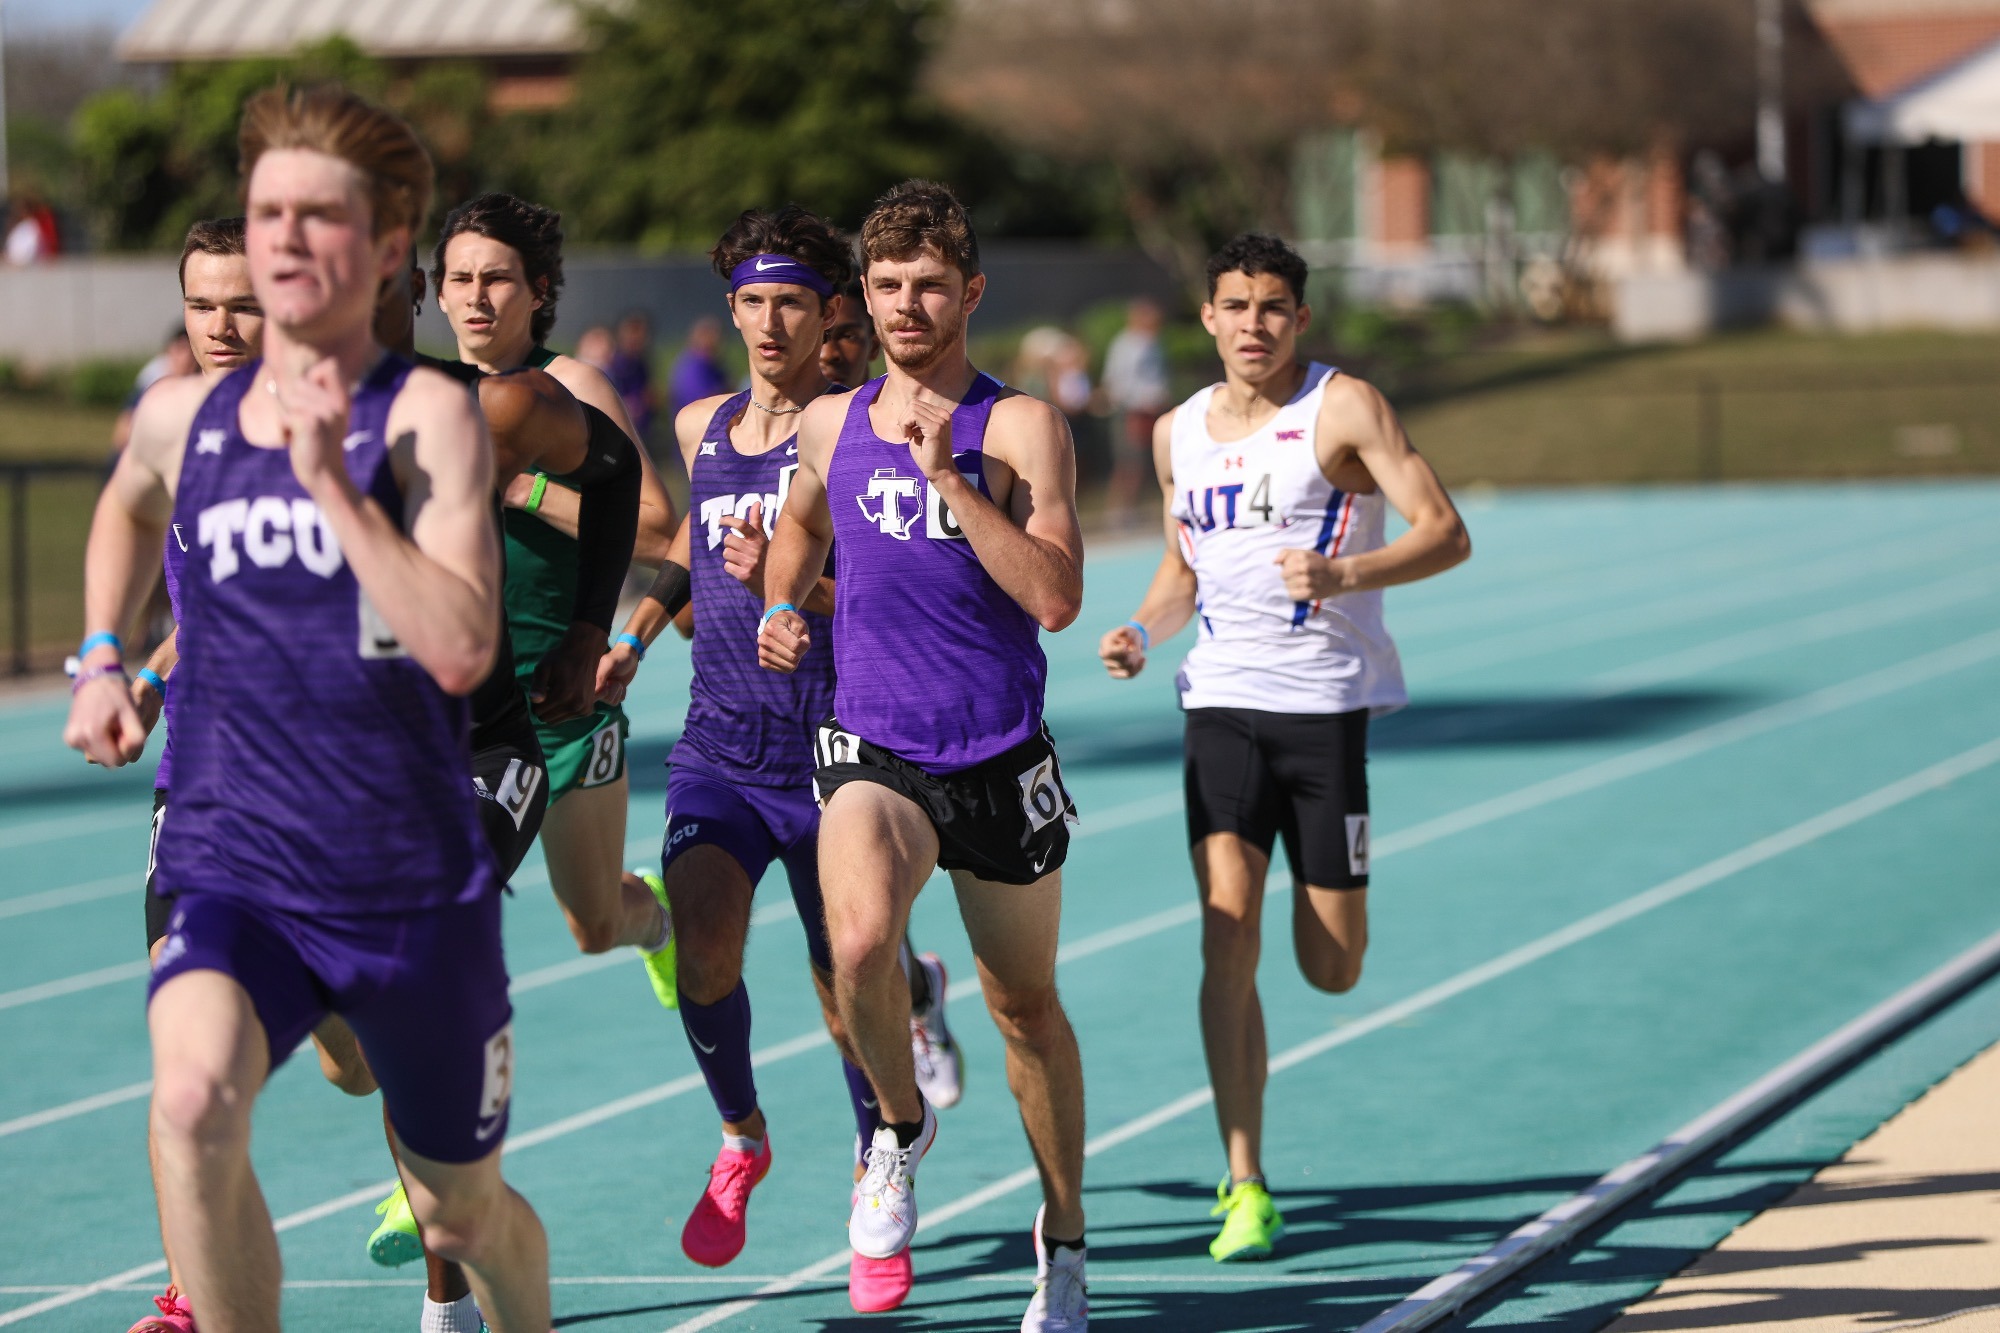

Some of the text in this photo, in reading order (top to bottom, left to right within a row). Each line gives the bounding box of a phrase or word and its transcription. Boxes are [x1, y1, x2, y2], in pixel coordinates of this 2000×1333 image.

[1188, 483, 1244, 533] UT
[1249, 473, 1273, 522] 4
[198, 496, 343, 585] TCU
[593, 730, 615, 781] 8
[506, 761, 536, 814] 9
[1030, 764, 1057, 821] 6
[664, 823, 699, 857] TCU
[1354, 820, 1368, 870] 4
